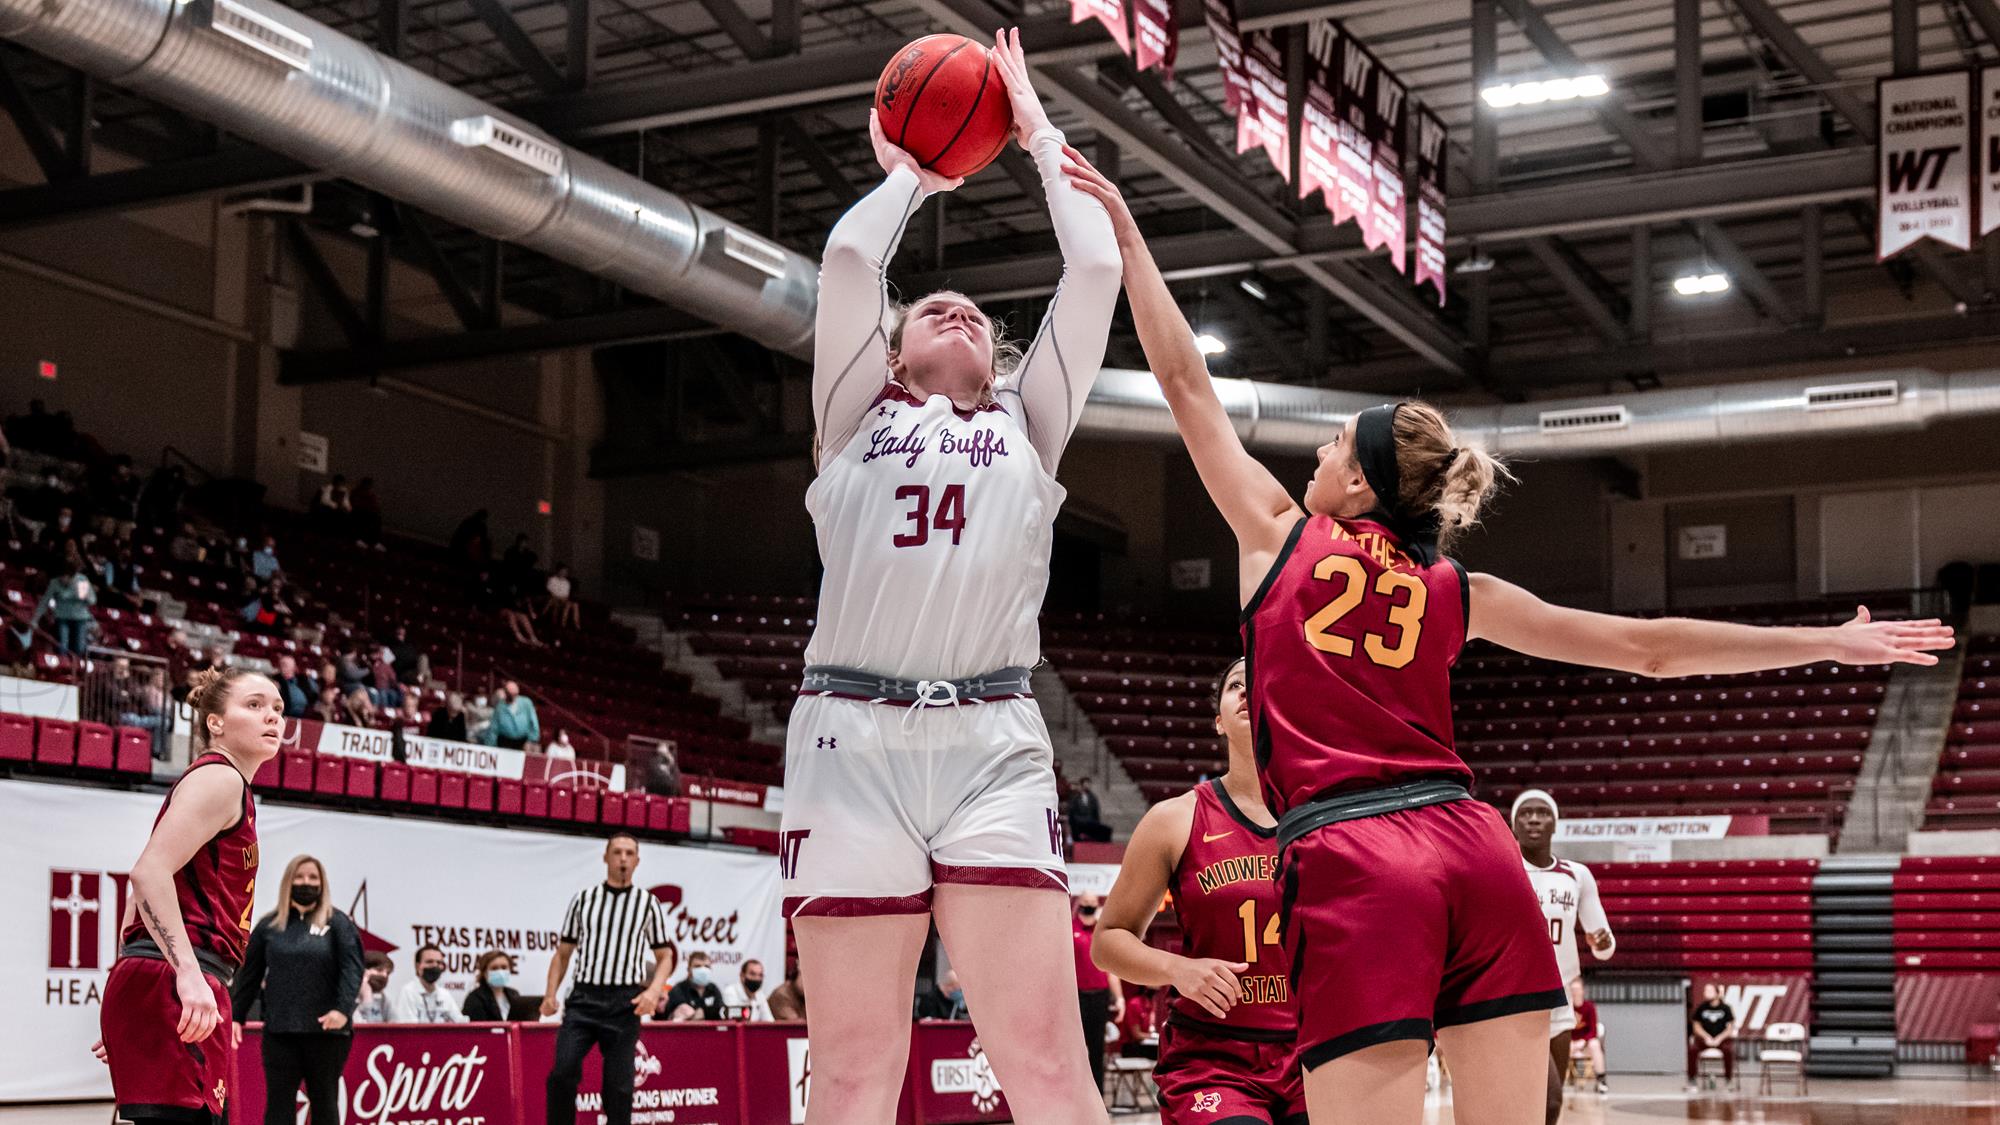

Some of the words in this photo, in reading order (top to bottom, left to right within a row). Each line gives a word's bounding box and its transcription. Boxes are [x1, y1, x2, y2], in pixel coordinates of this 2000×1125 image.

[1343, 38, 1374, 99] WT
[1376, 69, 1405, 127] WT
[1891, 97, 1957, 115] NATIONAL
[1886, 114, 1965, 134] CHAMPIONS
[1888, 146, 1962, 194] WT
[1891, 198, 1960, 213] VOLLEYBALL
[863, 423, 925, 469] Lady
[939, 428, 1009, 467] Buffs
[893, 484, 967, 548] 34
[1303, 553, 1428, 670] 23
[341, 731, 424, 760] TRADION
[442, 746, 498, 770] MOTION
[1565, 824, 1637, 836] TRADITION
[1656, 822, 1711, 834] MOTION
[1196, 855, 1280, 895] MIDWES
[412, 925, 471, 948] TEXAS
[475, 928, 522, 950] FARM
[526, 931, 560, 951] BUR
[45, 979, 101, 1006] HEA
[1241, 974, 1288, 1003] STAT
[352, 1044, 488, 1125] Spirit
[937, 1064, 970, 1086] FIRST
[660, 1088, 685, 1108] WAY
[685, 1086, 719, 1107] DINER
